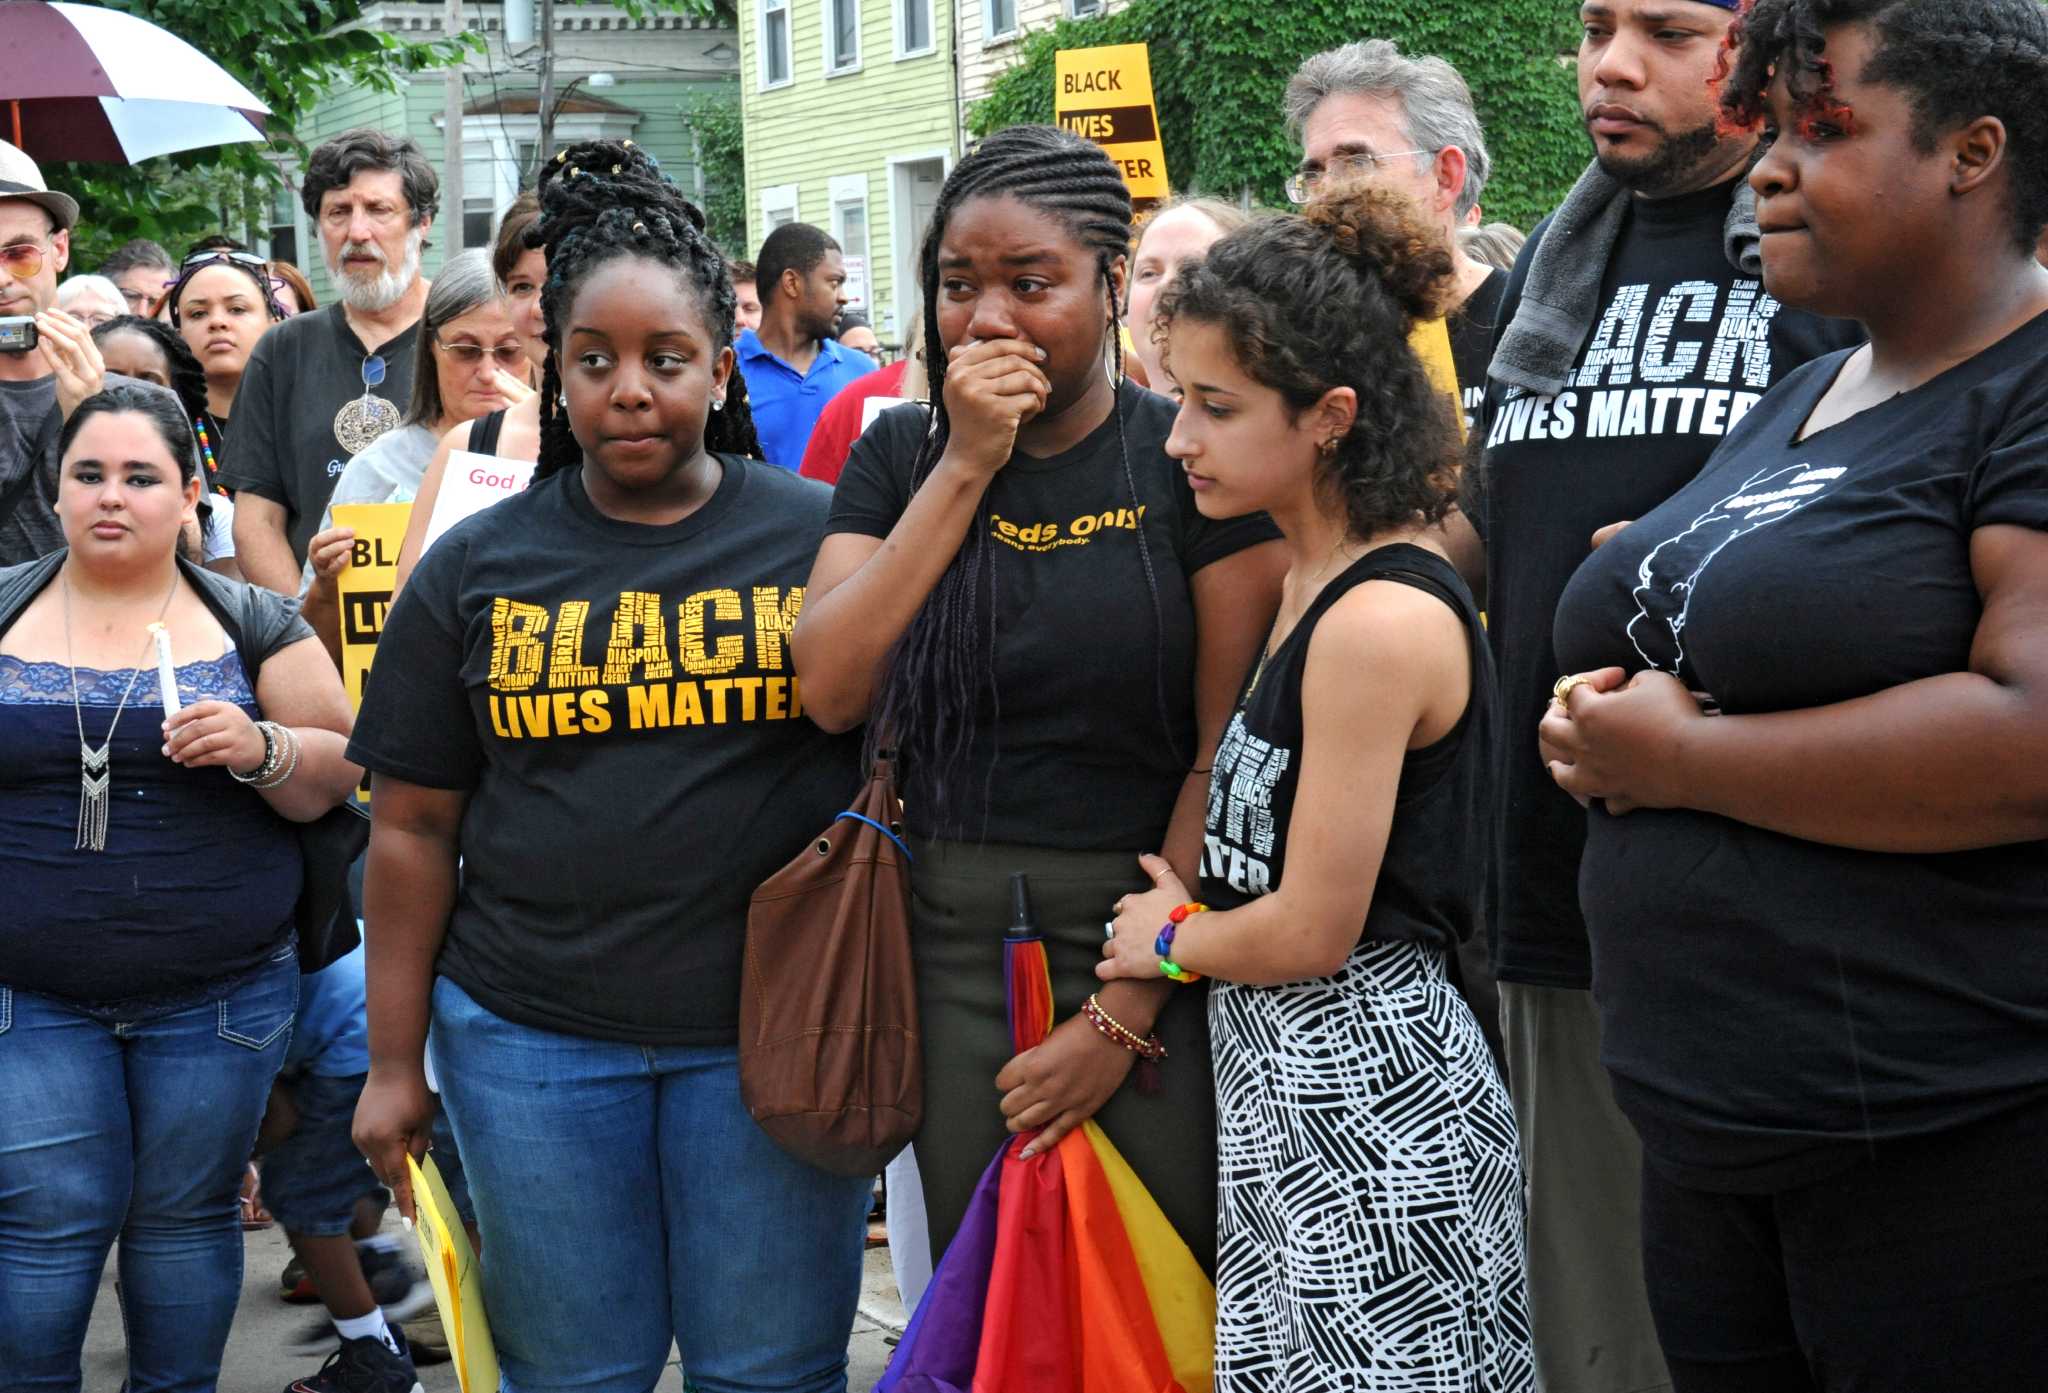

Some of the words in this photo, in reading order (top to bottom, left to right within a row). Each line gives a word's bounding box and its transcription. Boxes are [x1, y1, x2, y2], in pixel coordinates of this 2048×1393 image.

[1064, 69, 1122, 94] BLACK
[1063, 114, 1114, 138] LIVES
[1717, 318, 1767, 340] BLACK
[1584, 347, 1635, 366] DIASPORA
[1486, 394, 1577, 449] LIVES
[469, 468, 515, 490] God
[1070, 505, 1146, 536] Only
[686, 599, 704, 656] GUYANESE
[607, 646, 668, 664] DIASPORA
[549, 670, 599, 688] HAITIAN
[602, 673, 631, 685] CREOLE
[489, 690, 612, 738] LIVES
[627, 676, 799, 729] MATTE
[1231, 773, 1270, 809] BLACK
